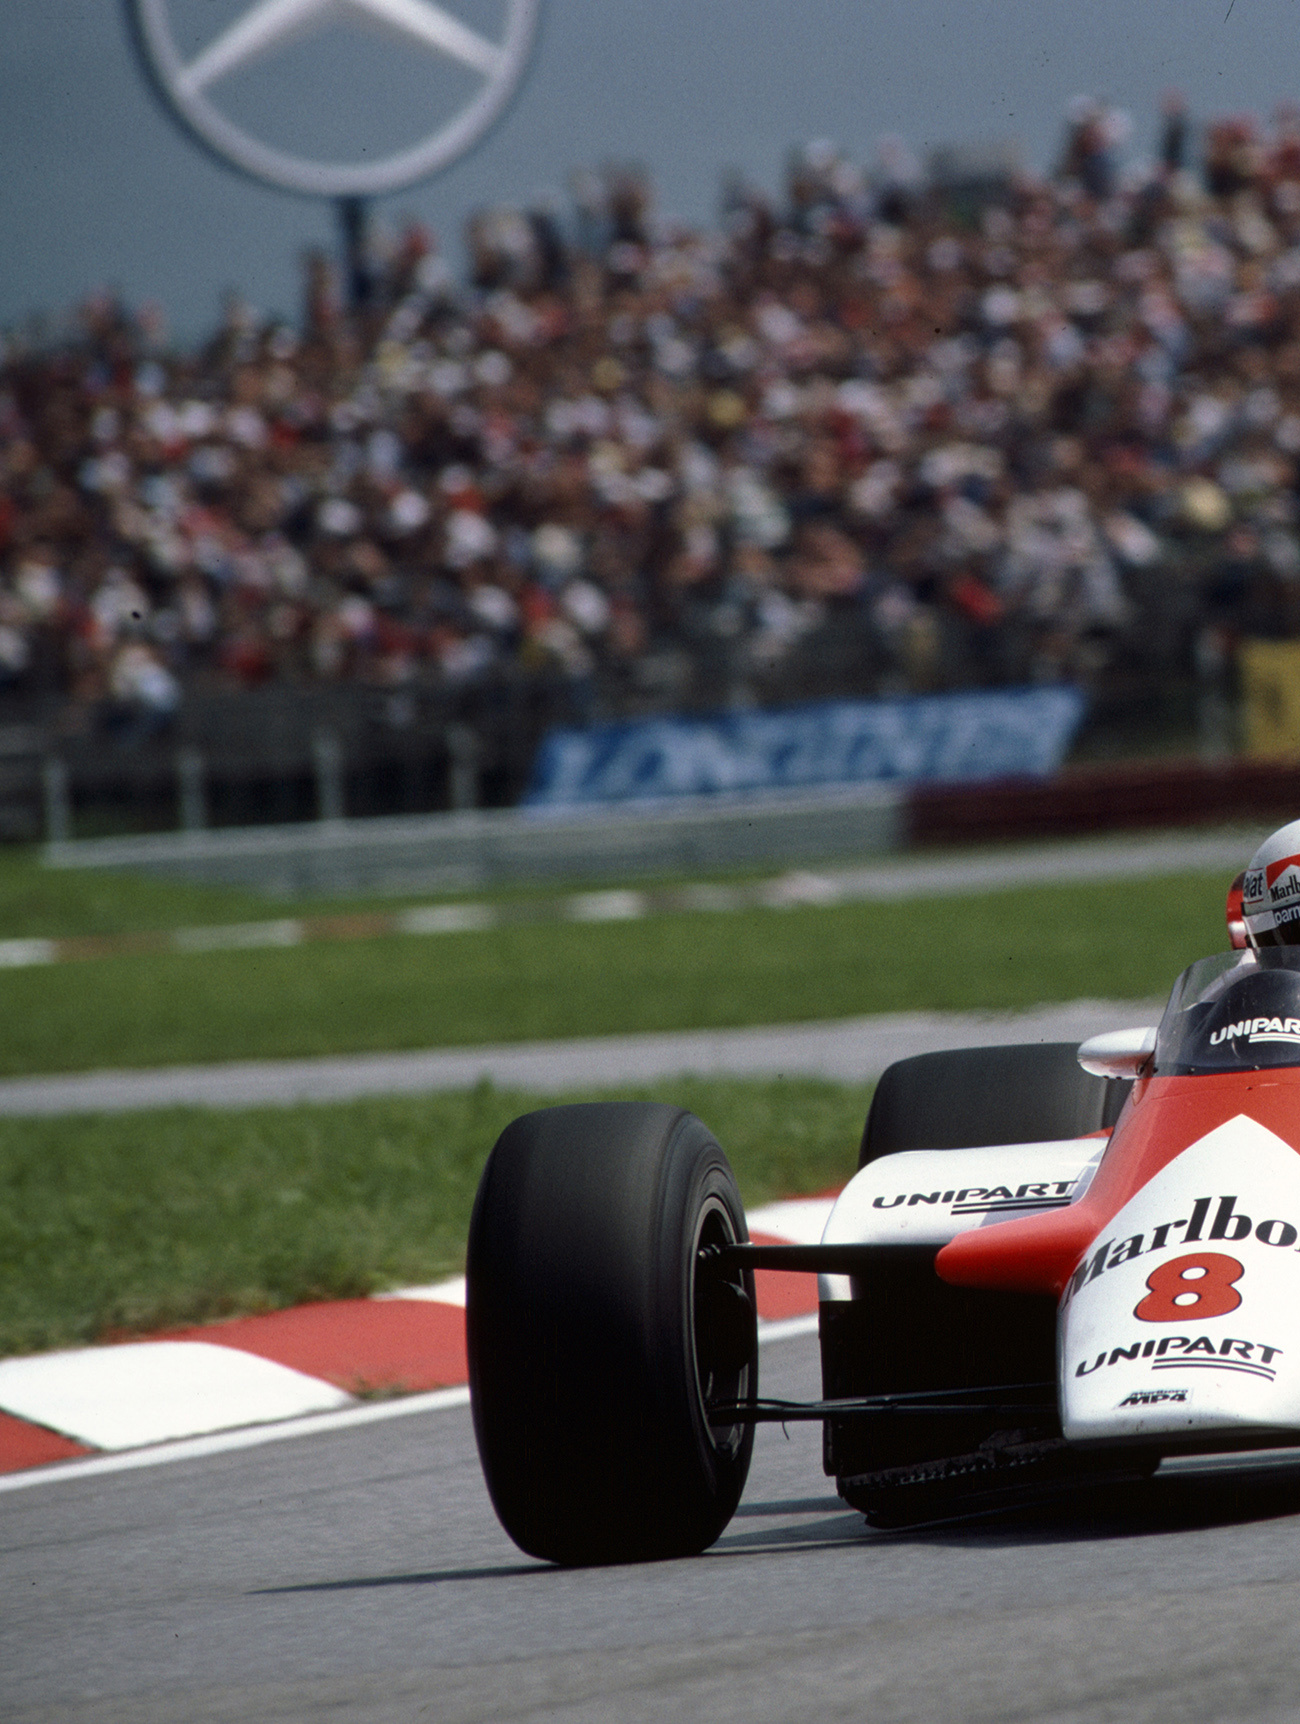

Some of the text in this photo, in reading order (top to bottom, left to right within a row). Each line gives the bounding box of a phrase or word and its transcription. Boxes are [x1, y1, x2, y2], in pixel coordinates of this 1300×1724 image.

[871, 1179, 1079, 1211] UNIPART
[1132, 1251, 1246, 1323] 8
[1074, 1335, 1284, 1379] UNIPART
[1118, 1393, 1188, 1407] MP4
